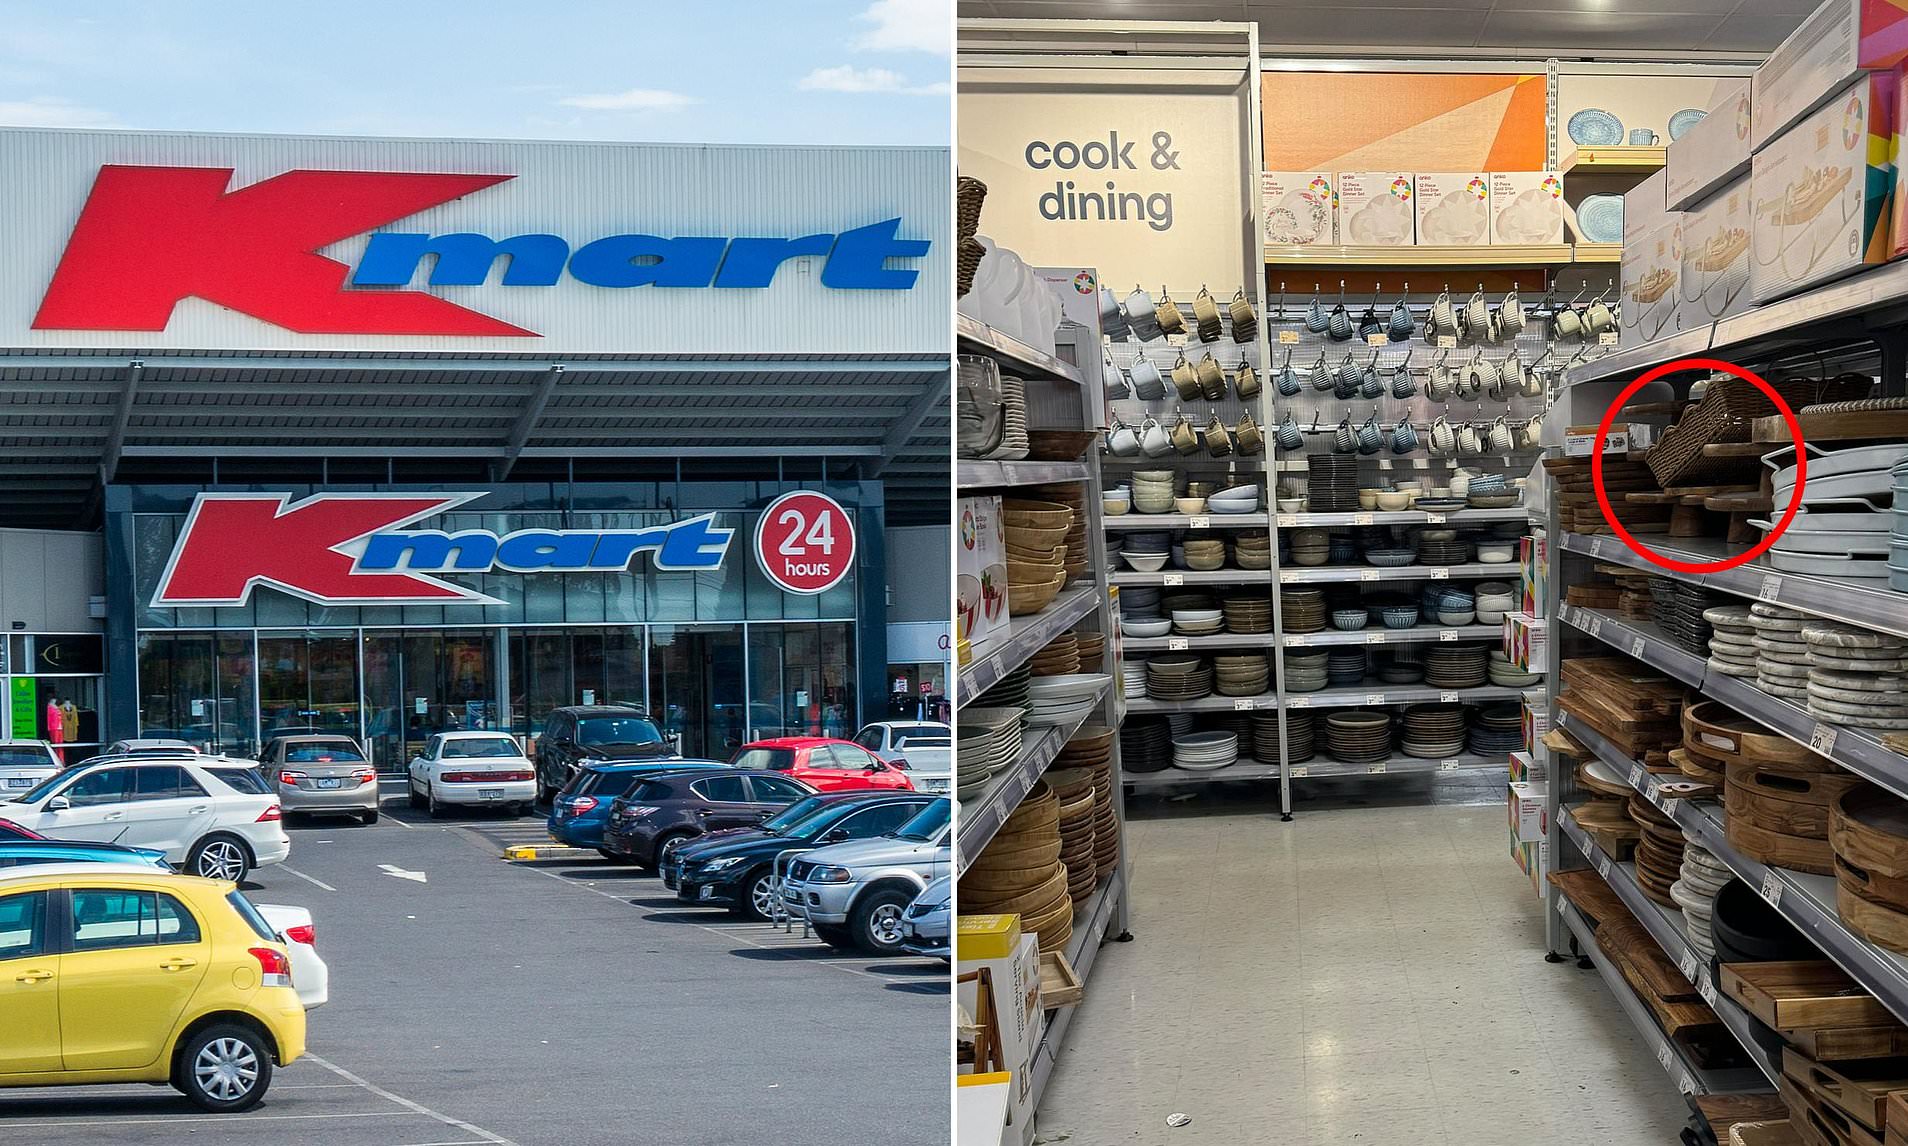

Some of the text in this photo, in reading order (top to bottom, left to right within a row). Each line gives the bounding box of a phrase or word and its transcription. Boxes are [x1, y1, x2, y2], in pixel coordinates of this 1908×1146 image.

[1025, 130, 1181, 170] cook &
[1039, 181, 1173, 231] dining
[31, 164, 931, 338] Kmart
[151, 492, 736, 607] Kmart
[778, 509, 836, 556] 24
[784, 558, 831, 577] hours
[1812, 735, 1822, 749] 20
